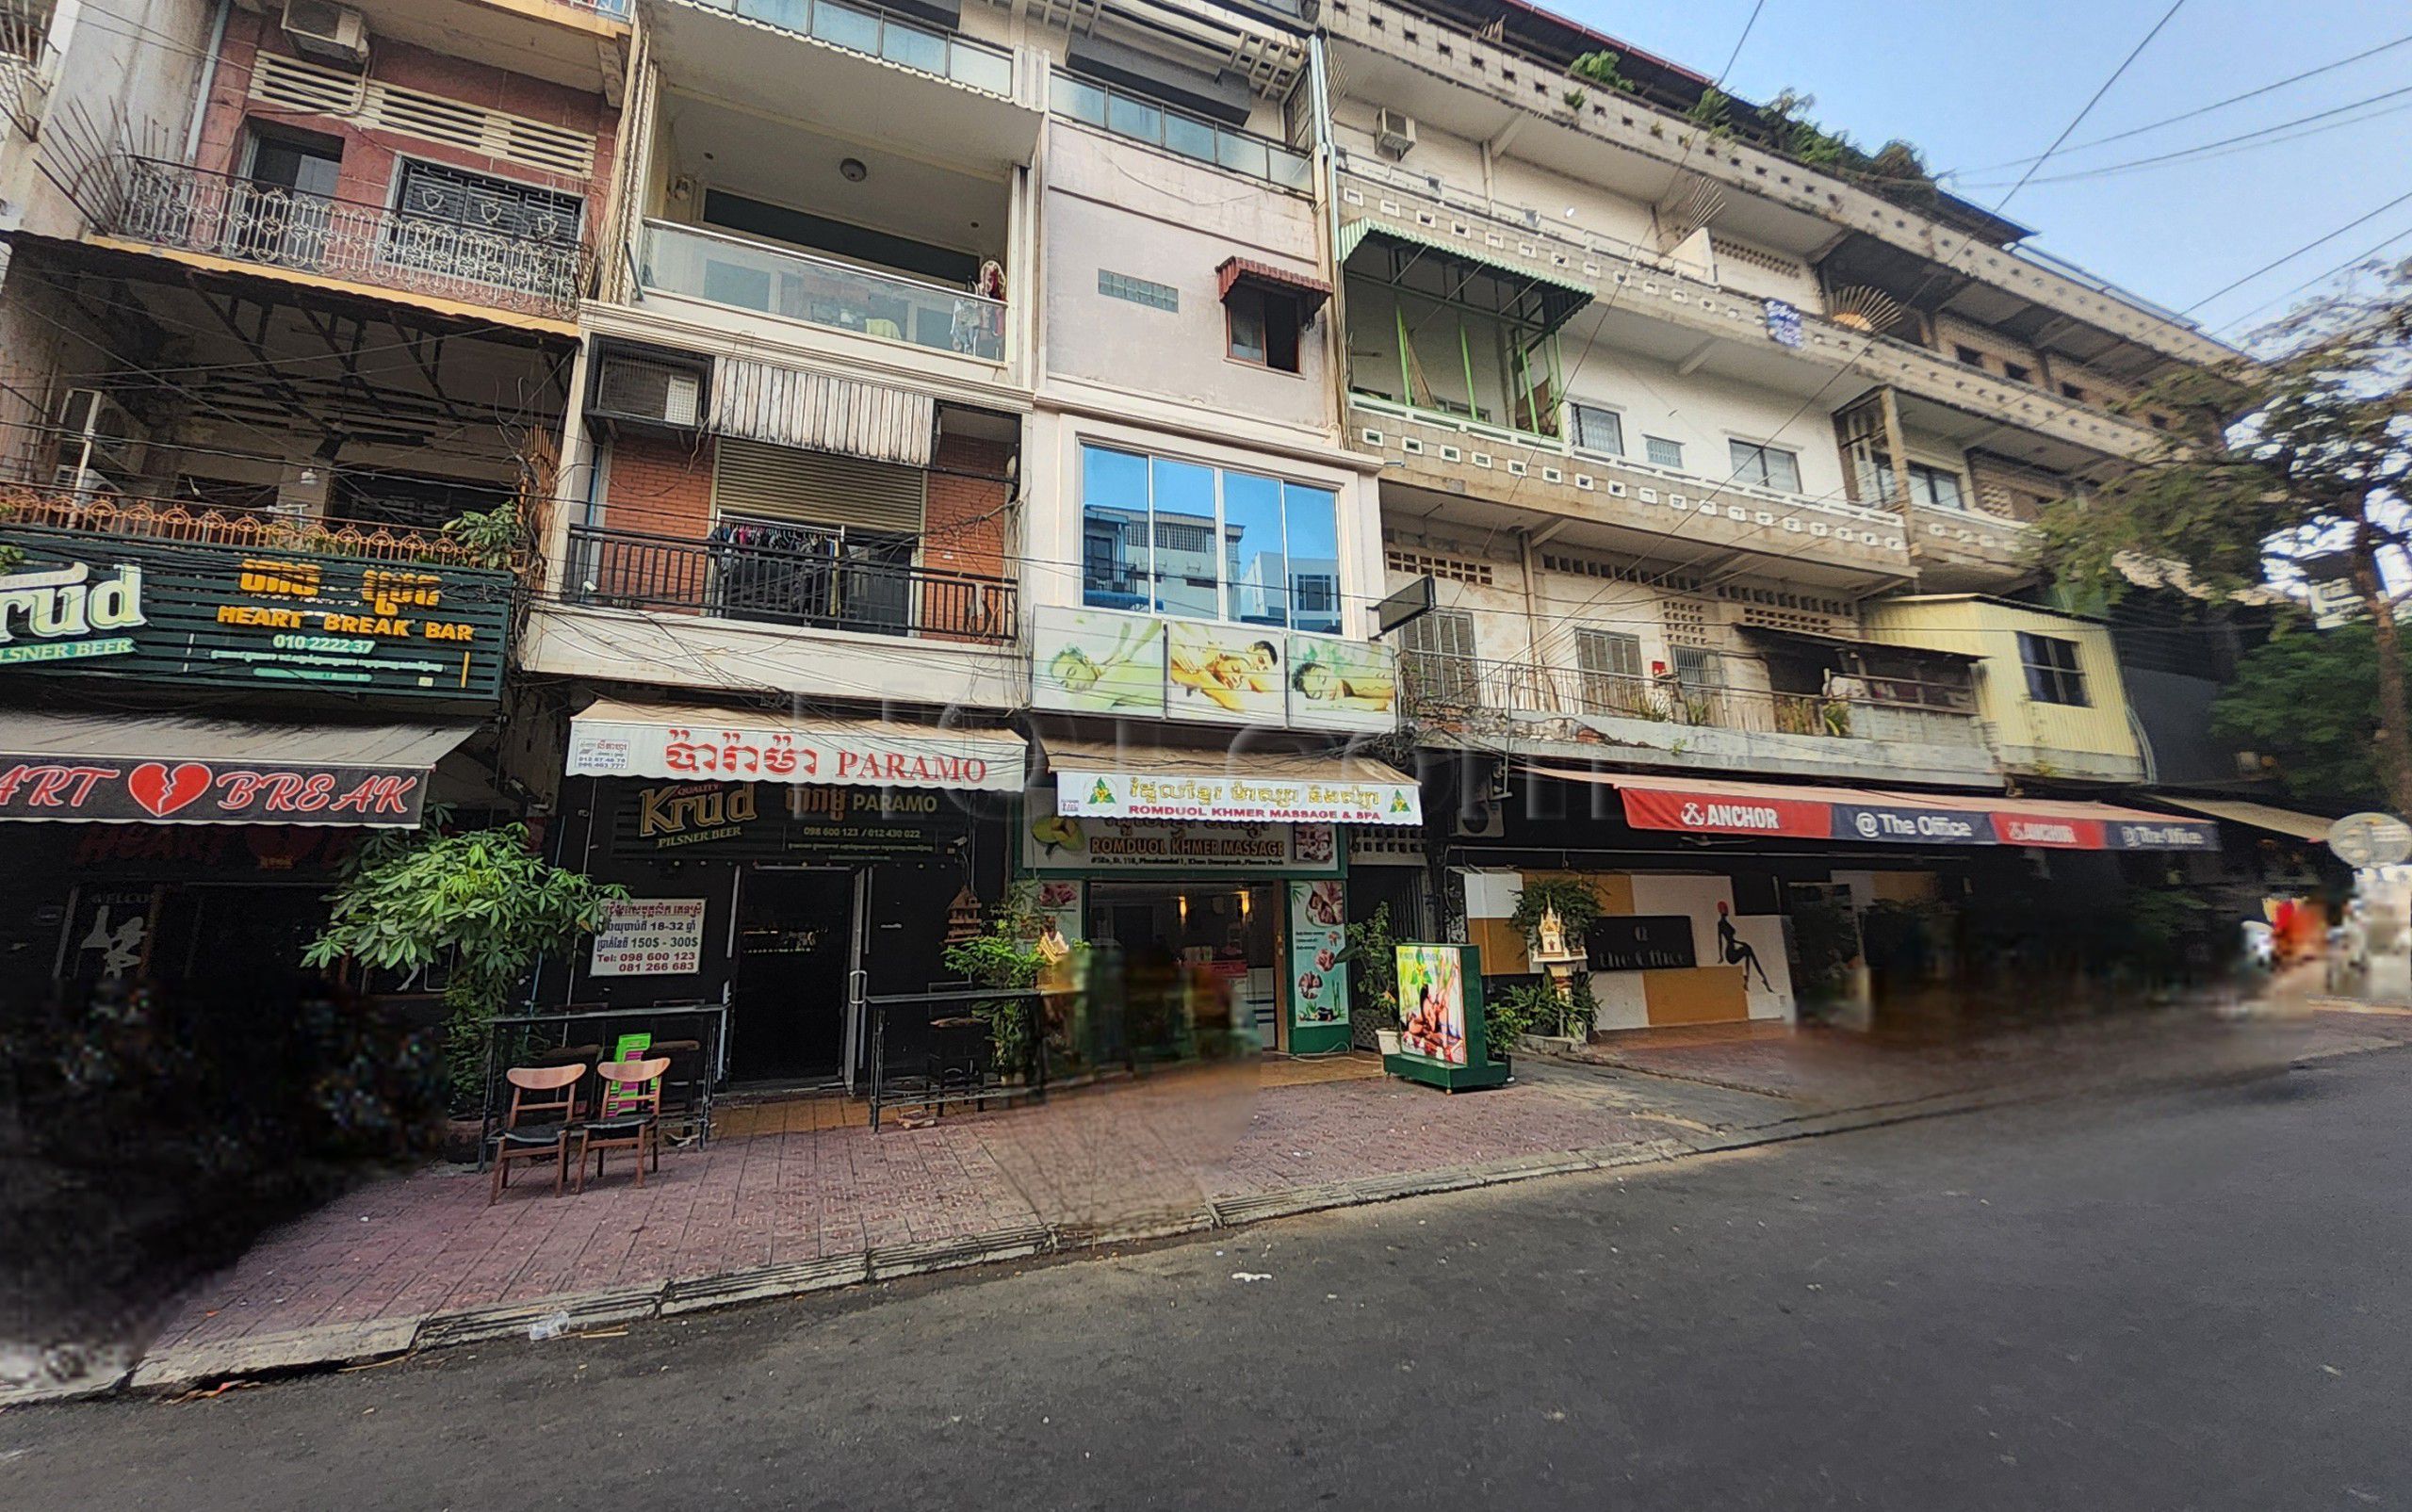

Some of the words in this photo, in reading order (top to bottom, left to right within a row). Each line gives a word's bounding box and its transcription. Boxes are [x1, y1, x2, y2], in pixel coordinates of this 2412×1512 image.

[217, 606, 305, 628] HEART
[323, 614, 411, 638] BREAK
[425, 622, 475, 642] BAR
[75, 638, 134, 658] BEER
[837, 750, 986, 783] PARAMO
[218, 772, 417, 814] BREAK
[677, 783, 720, 796] QUALITY
[640, 782, 758, 837] Krud
[853, 793, 937, 813] PARAMO
[1129, 805, 1207, 817] ROMDUOL
[1212, 807, 1265, 818] KHMER
[1269, 809, 1338, 819] MASSAGE
[1342, 811, 1352, 820] &
[1356, 812, 1381, 821] SPA
[1706, 805, 1780, 829] ANCHOR
[1919, 815, 1973, 837] Office
[657, 832, 709, 848] PILSNER
[711, 826, 742, 838] BEER
[823, 827, 839, 837] 600
[842, 828, 858, 837] 123
[1090, 837, 1167, 855] ROMDUOL
[1169, 837, 1221, 856] KHMER
[1222, 839, 1285, 857] MASSAGE
[650, 921, 684, 931] 18-32
[631, 937, 660, 949] 150$
[670, 936, 699, 948] 300$
[597, 953, 617, 963] Tel:
[620, 953, 643, 962] 098
[646, 952, 670, 962] 600
[674, 952, 695, 961] 123
[619, 963, 641, 972] 081
[645, 963, 669, 971] 266
[672, 962, 694, 971] 683
